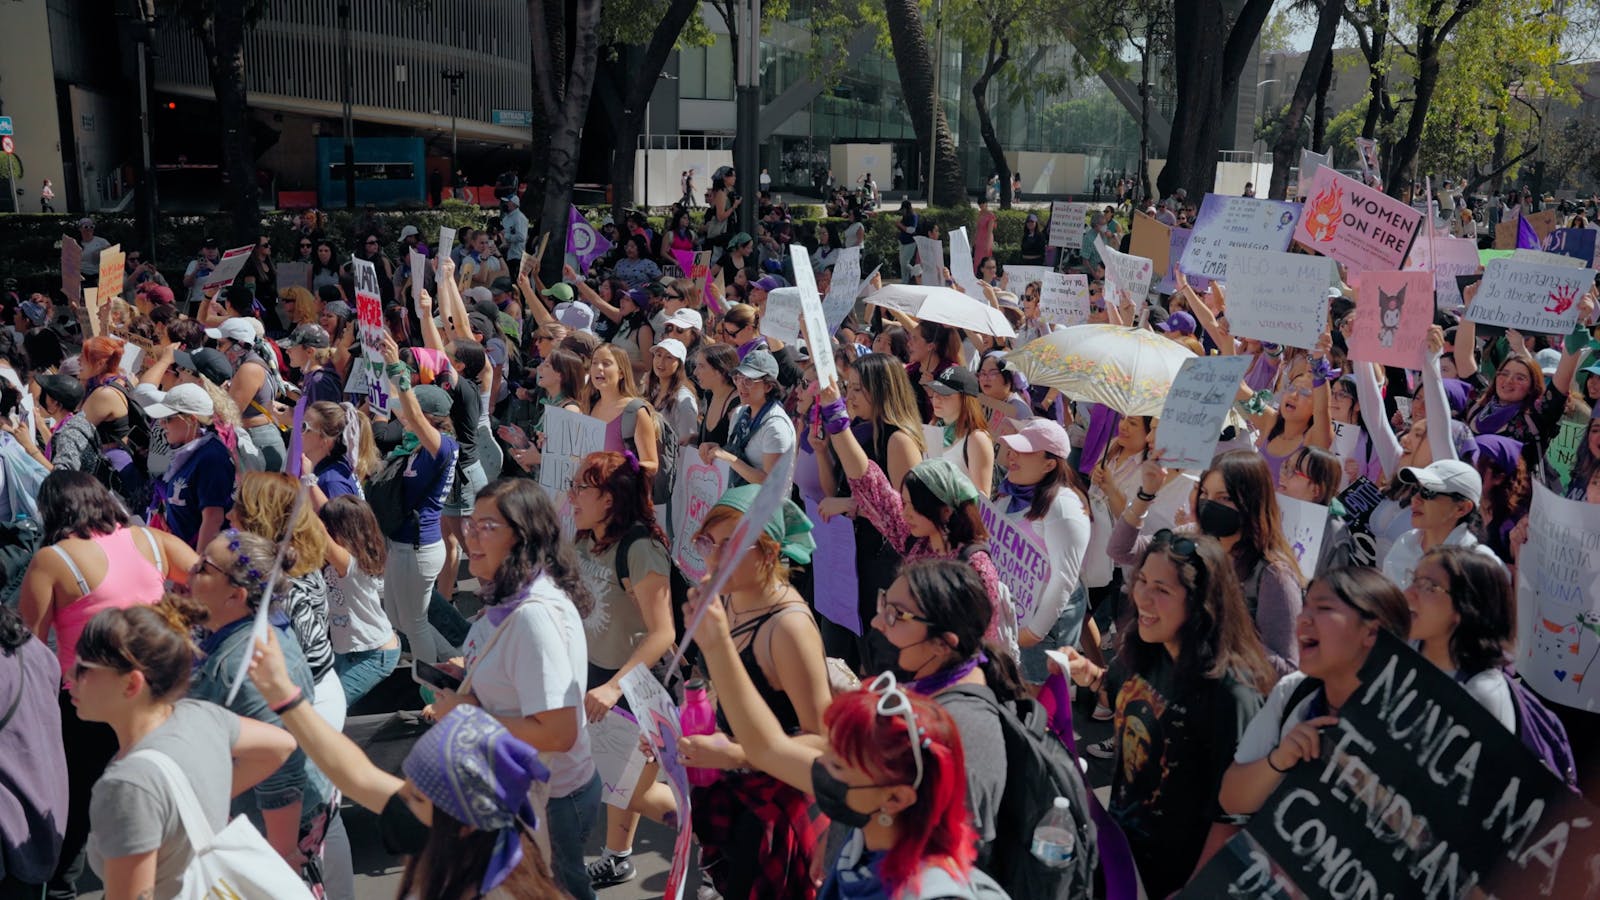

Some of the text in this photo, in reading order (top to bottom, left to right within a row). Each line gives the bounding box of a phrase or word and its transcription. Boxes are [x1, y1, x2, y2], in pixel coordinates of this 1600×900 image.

[1342, 213, 1369, 234] ON
[1371, 226, 1406, 254] FIRE
[1351, 192, 1414, 234] WOMEN
[1001, 552, 1035, 591] SOMOS
[1361, 653, 1483, 806] NUNCA
